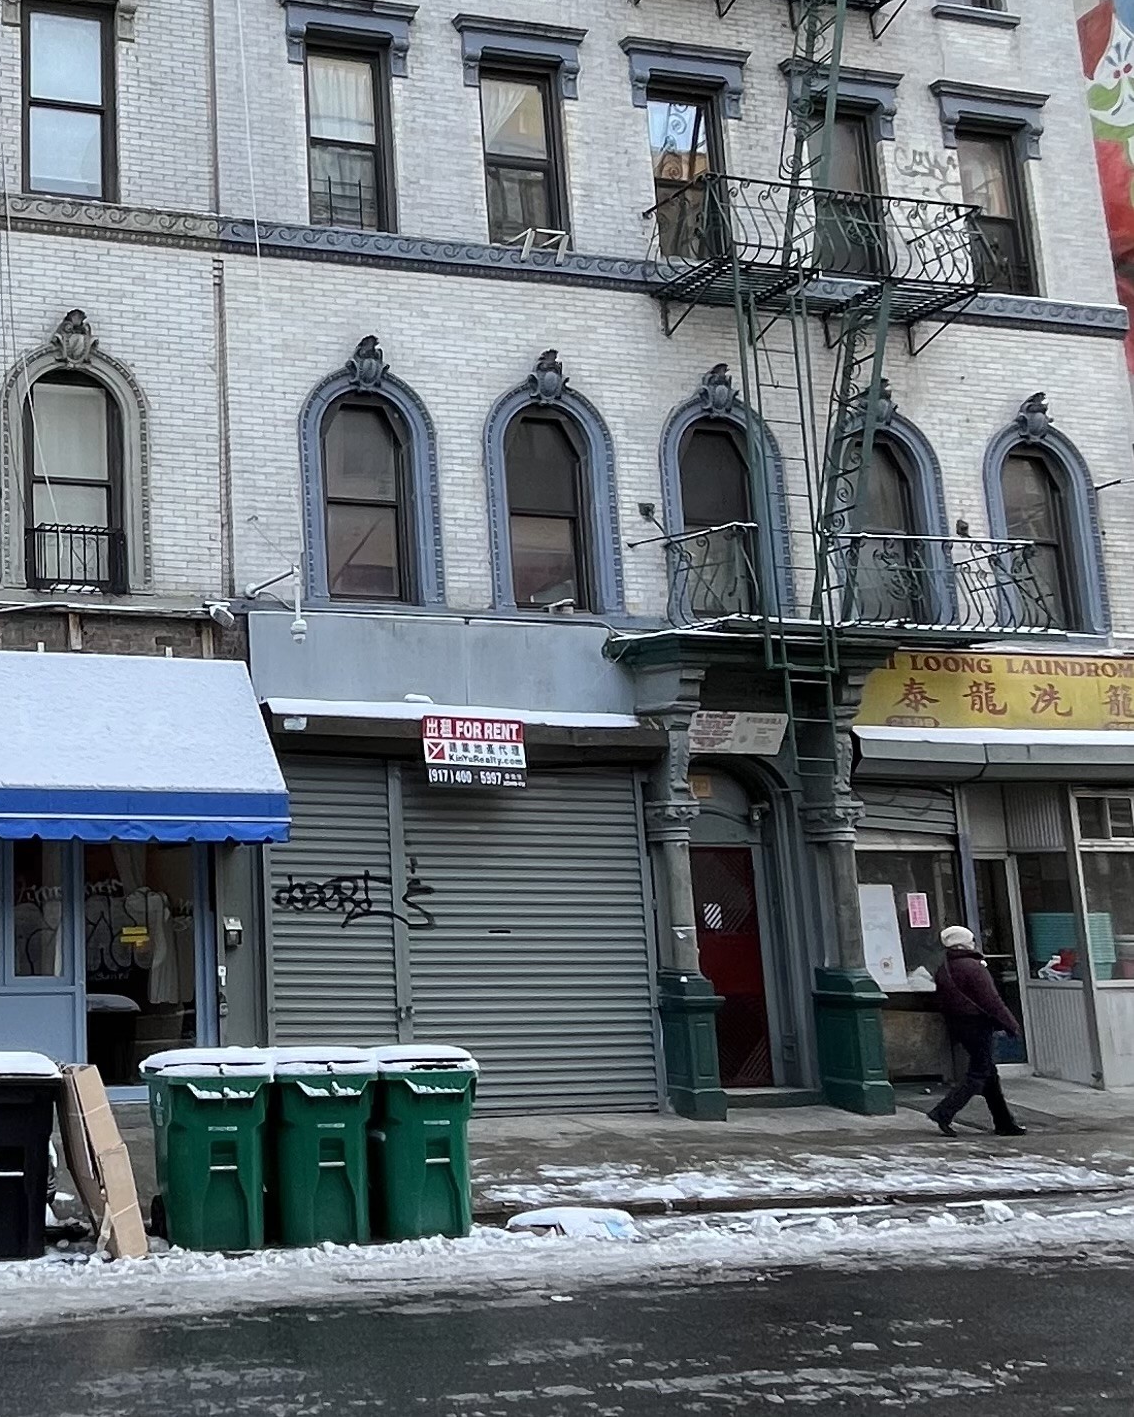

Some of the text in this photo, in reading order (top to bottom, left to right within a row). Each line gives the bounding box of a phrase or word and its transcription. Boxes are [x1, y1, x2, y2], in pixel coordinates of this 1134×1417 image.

[910, 654, 993, 674] LOONG
[426, 717, 453, 738] 出租
[455, 720, 520, 742] FOR RENT
